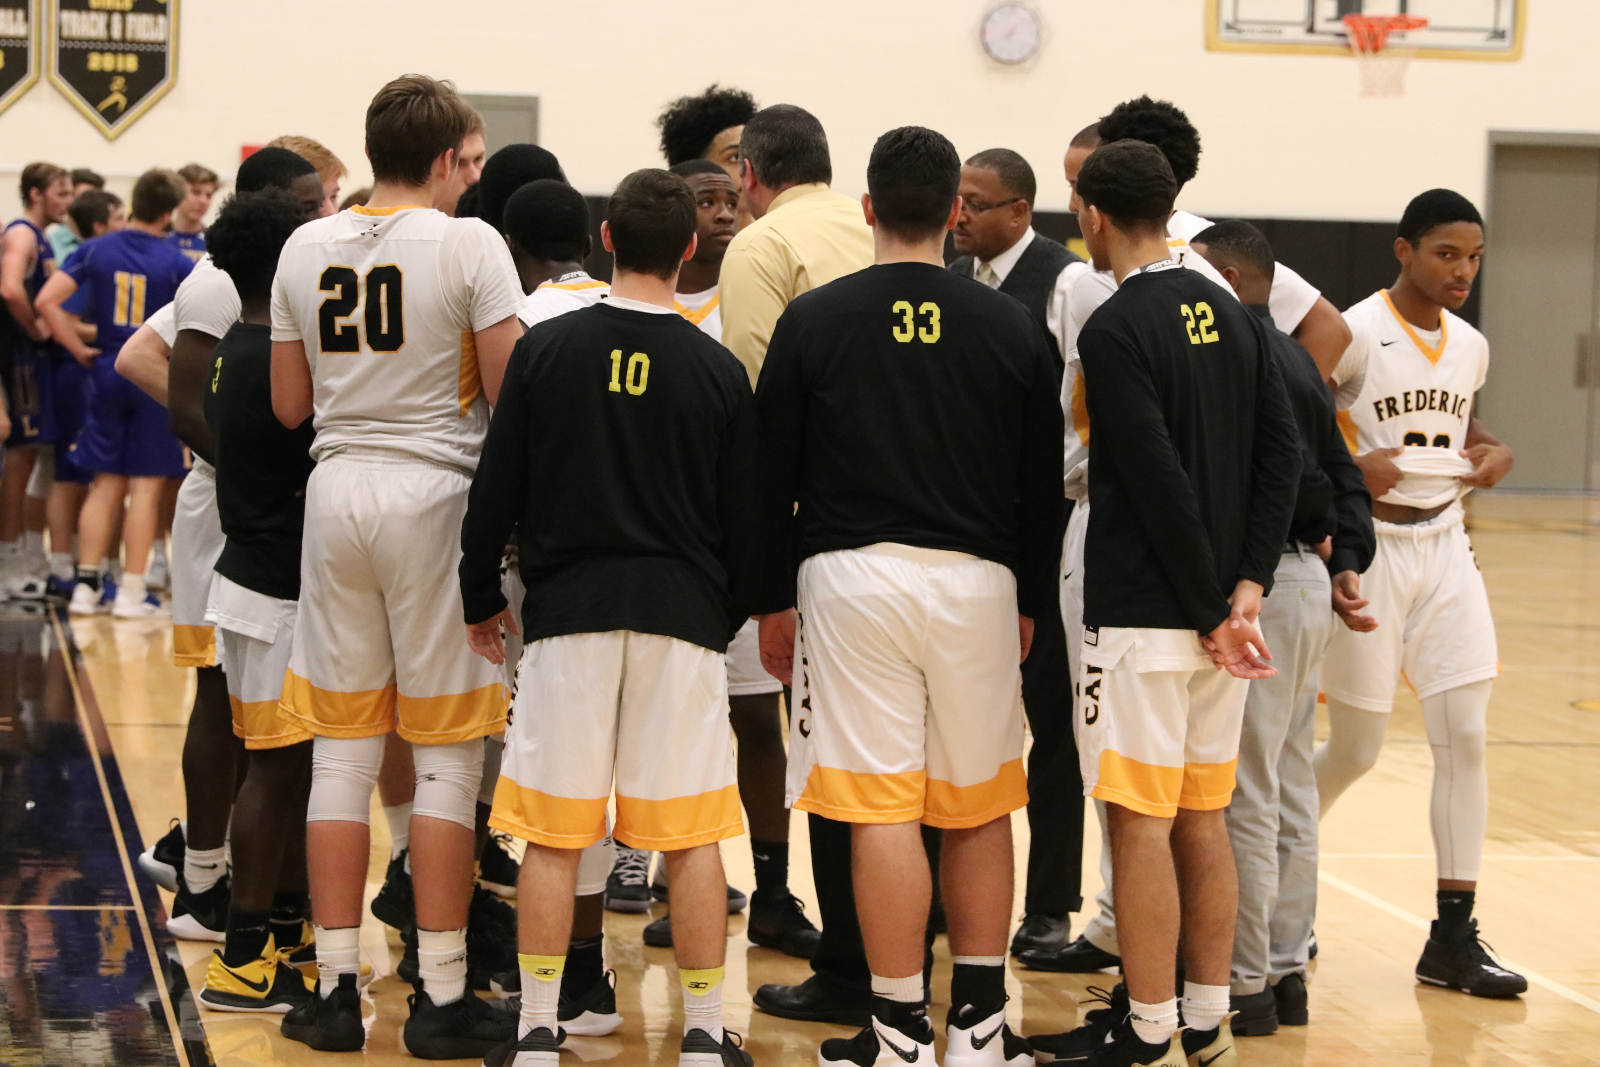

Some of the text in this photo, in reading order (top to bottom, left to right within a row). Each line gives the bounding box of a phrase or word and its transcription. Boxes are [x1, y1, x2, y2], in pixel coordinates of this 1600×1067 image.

[113, 271, 147, 327] 11
[318, 263, 405, 354] 20
[892, 300, 941, 344] 33
[1180, 302, 1220, 345] 22
[608, 349, 650, 396] 10
